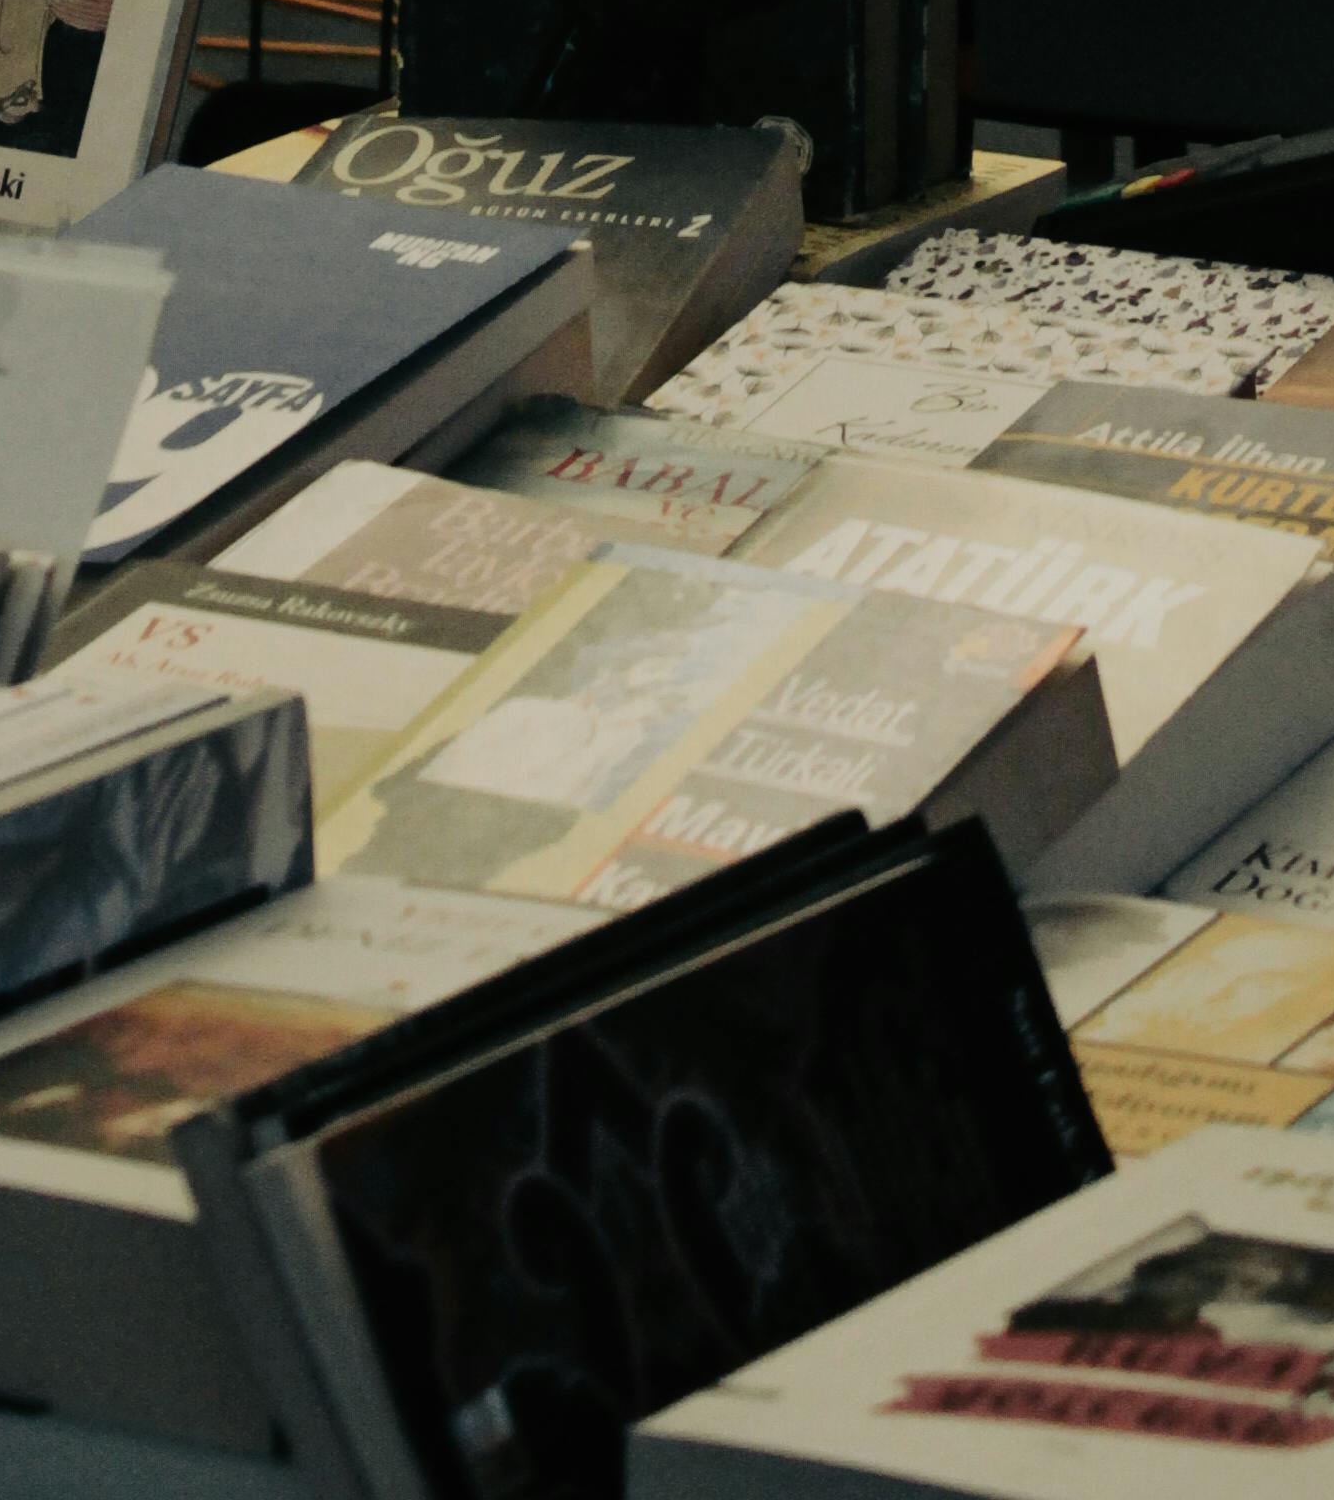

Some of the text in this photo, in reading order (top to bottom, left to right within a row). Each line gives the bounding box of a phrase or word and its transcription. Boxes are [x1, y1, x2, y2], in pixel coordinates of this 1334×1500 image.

[331, 123, 637, 207] Oğuz
[1074, 420, 1208, 461] Attila
[782, 515, 1217, 658] ATATÜRK
[134, 615, 216, 651] VS
[775, 672, 921, 732] Vedat
[717, 726, 879, 790] Türkali
